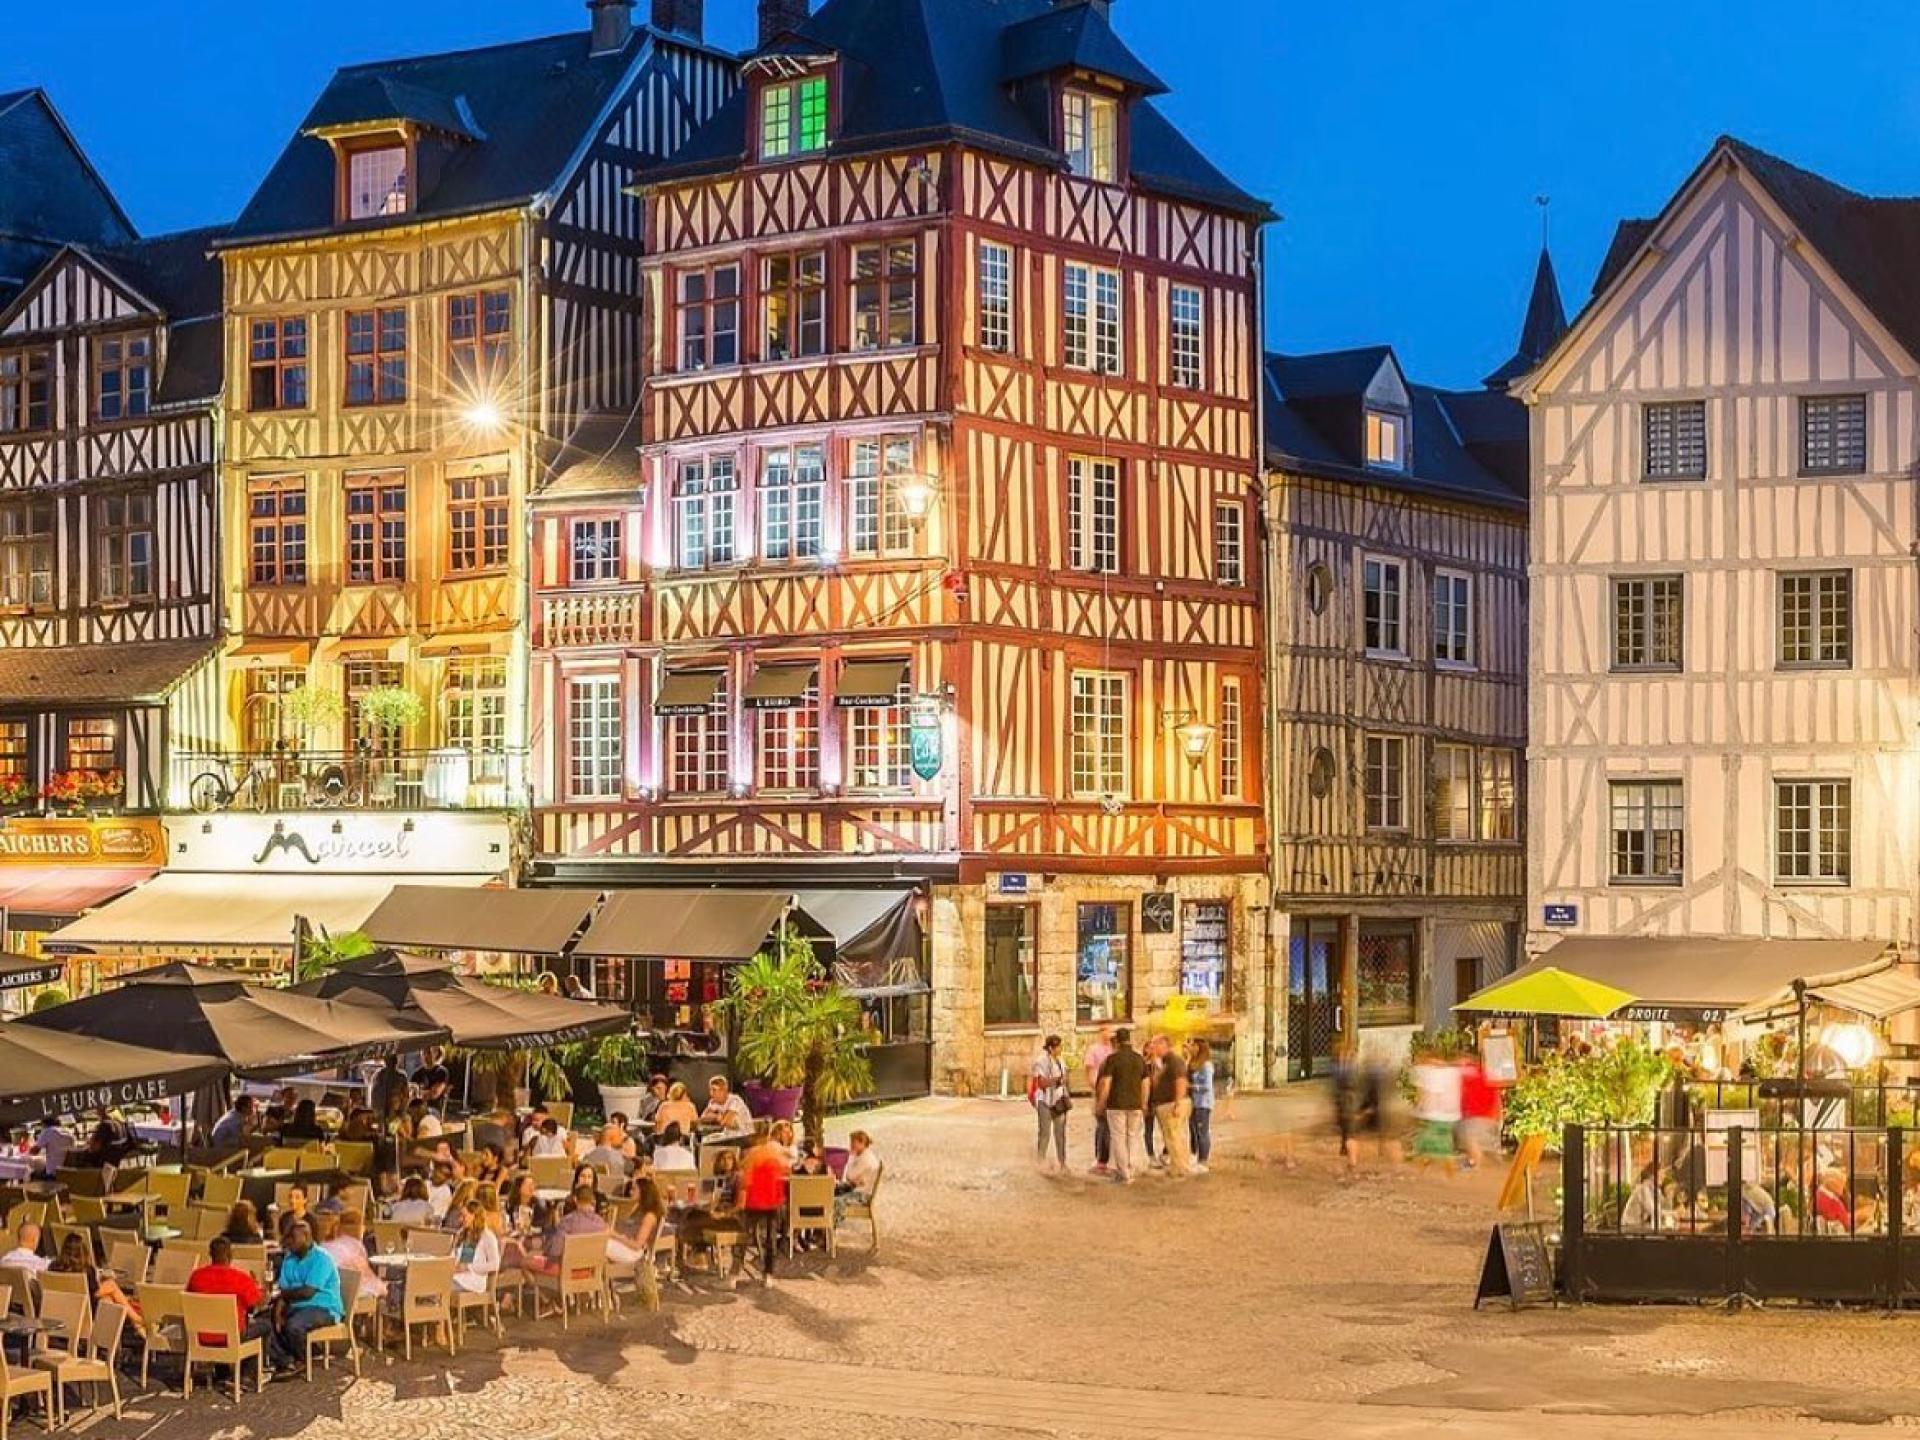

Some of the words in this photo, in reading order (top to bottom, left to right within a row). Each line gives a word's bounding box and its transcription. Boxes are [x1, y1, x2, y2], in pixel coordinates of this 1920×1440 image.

[253, 832, 409, 864] Marcel
[1627, 1008, 1670, 1020] DROITE
[41, 1087, 113, 1116] L'EURO
[121, 1079, 168, 1101] CAFE
